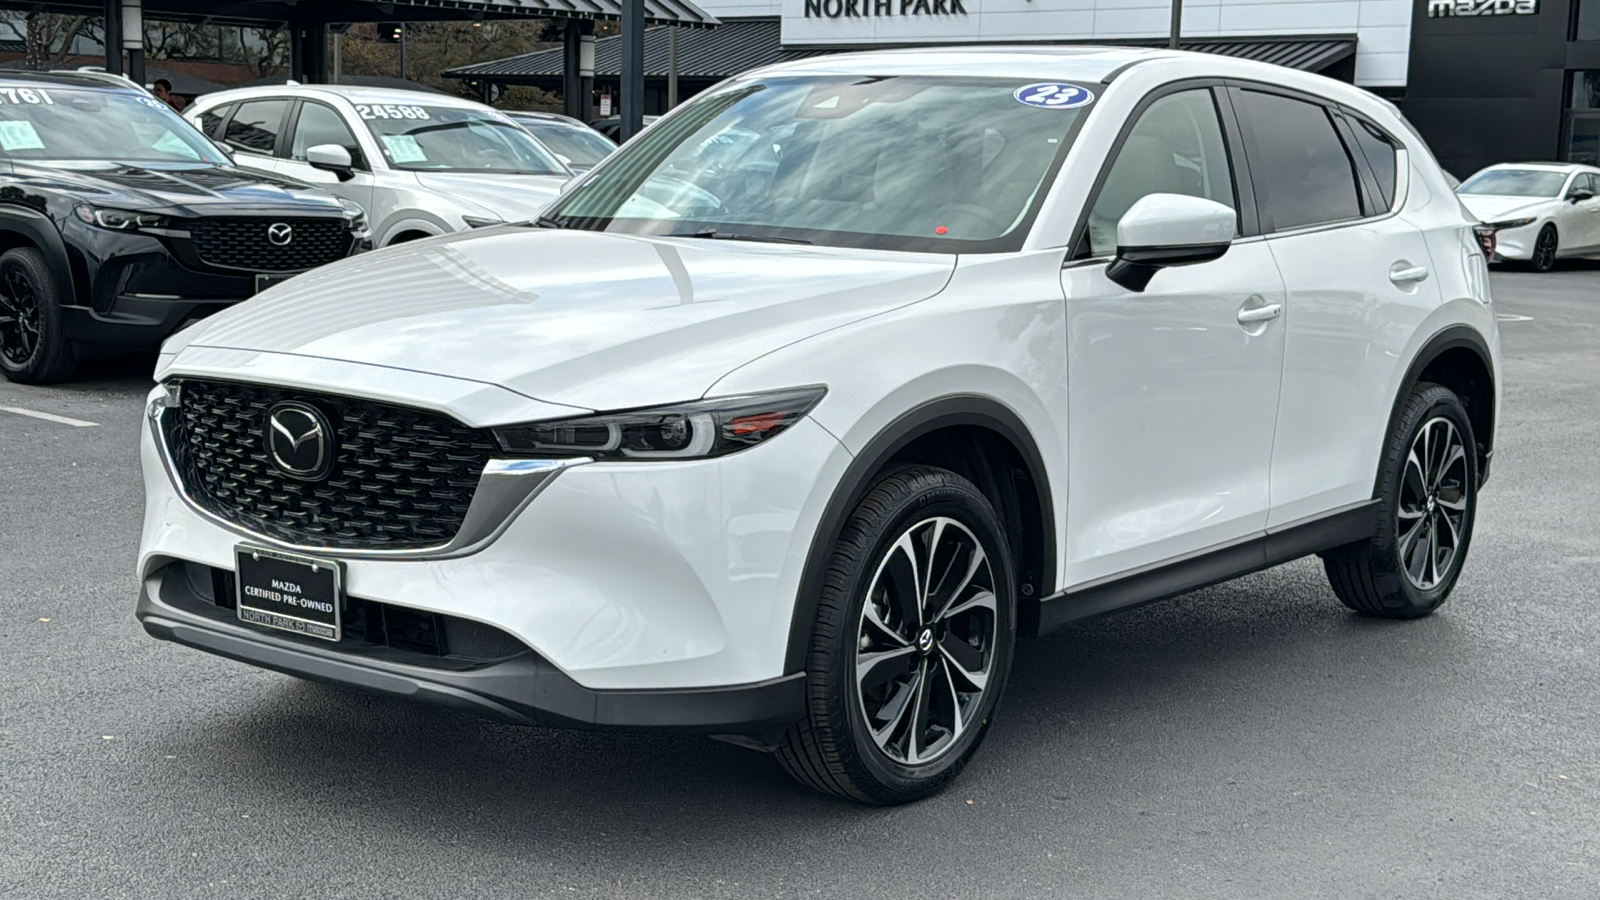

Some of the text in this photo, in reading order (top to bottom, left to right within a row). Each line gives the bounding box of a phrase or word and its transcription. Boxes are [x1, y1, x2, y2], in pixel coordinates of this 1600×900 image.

[804, 0, 967, 18] NORTH PARK
[0, 87, 54, 105] 761
[1025, 85, 1079, 105] 23
[355, 104, 431, 120] 24588
[271, 579, 302, 594] MAZDA
[244, 585, 333, 613] CERTIFIED PRE-OWNED
[242, 610, 271, 624] NORTH
[272, 616, 295, 630] PARK
